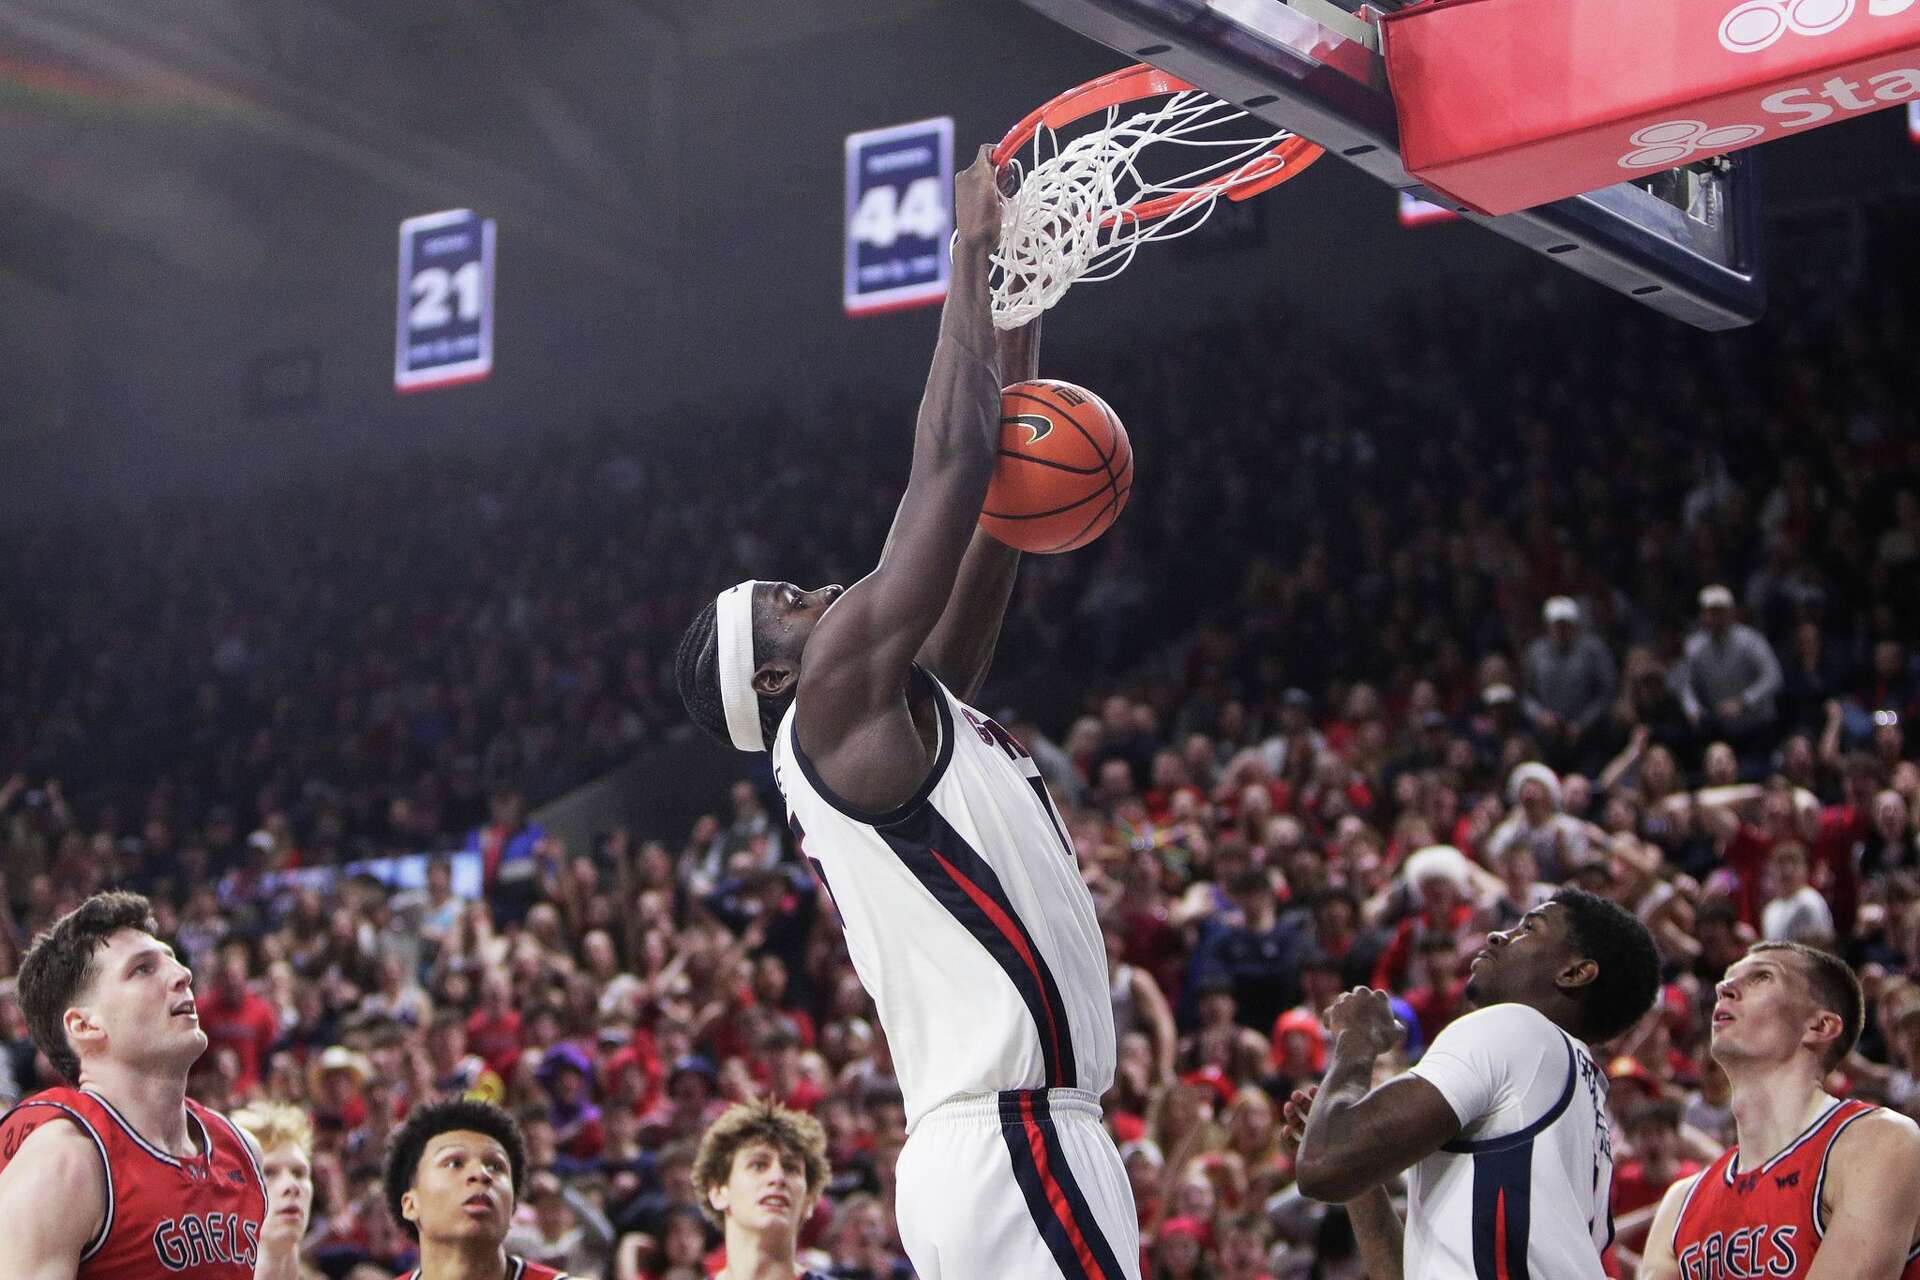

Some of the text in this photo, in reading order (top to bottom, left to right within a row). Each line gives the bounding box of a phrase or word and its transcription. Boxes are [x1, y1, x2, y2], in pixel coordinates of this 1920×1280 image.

[1760, 68, 1920, 128] Sta
[851, 178, 946, 247] 44
[409, 263, 481, 329] 21
[153, 1212, 258, 1271] GAELS
[1679, 1225, 1798, 1280] GAELS
